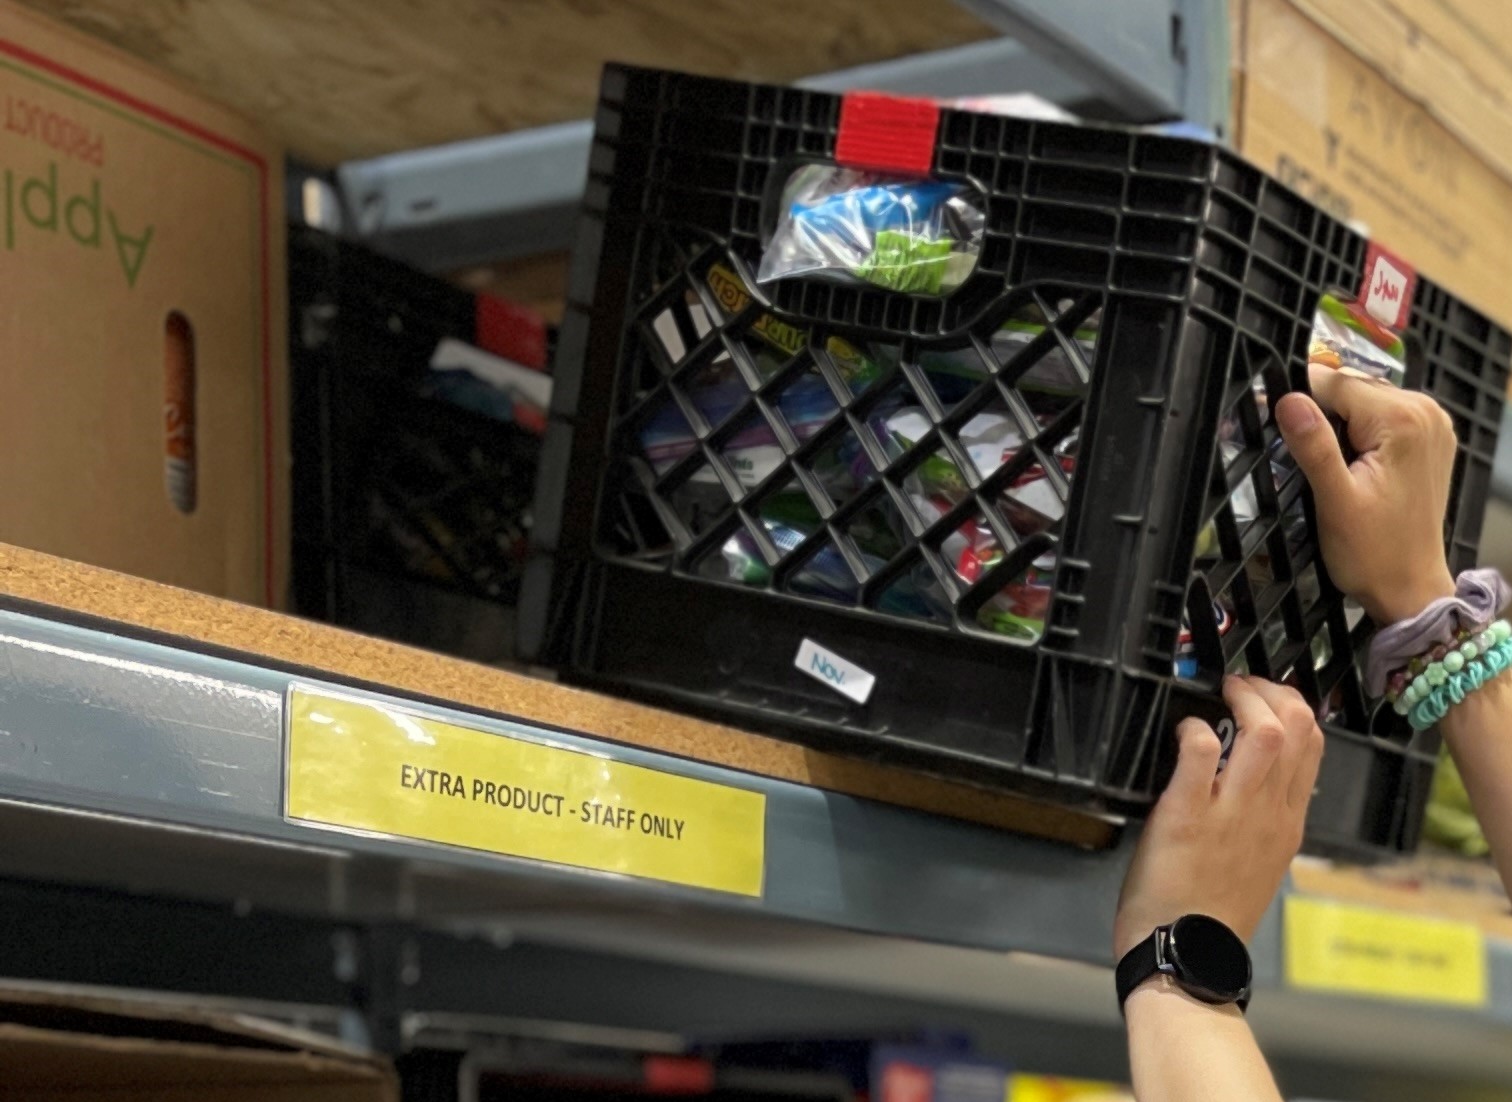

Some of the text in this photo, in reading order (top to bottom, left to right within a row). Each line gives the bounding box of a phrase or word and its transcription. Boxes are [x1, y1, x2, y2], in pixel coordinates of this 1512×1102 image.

[4, 161, 156, 289] Appl
[400, 764, 466, 799] EXTRA
[472, 779, 565, 817] PRODUCT
[580, 801, 635, 831] STAFF
[640, 813, 685, 840] ONLY
